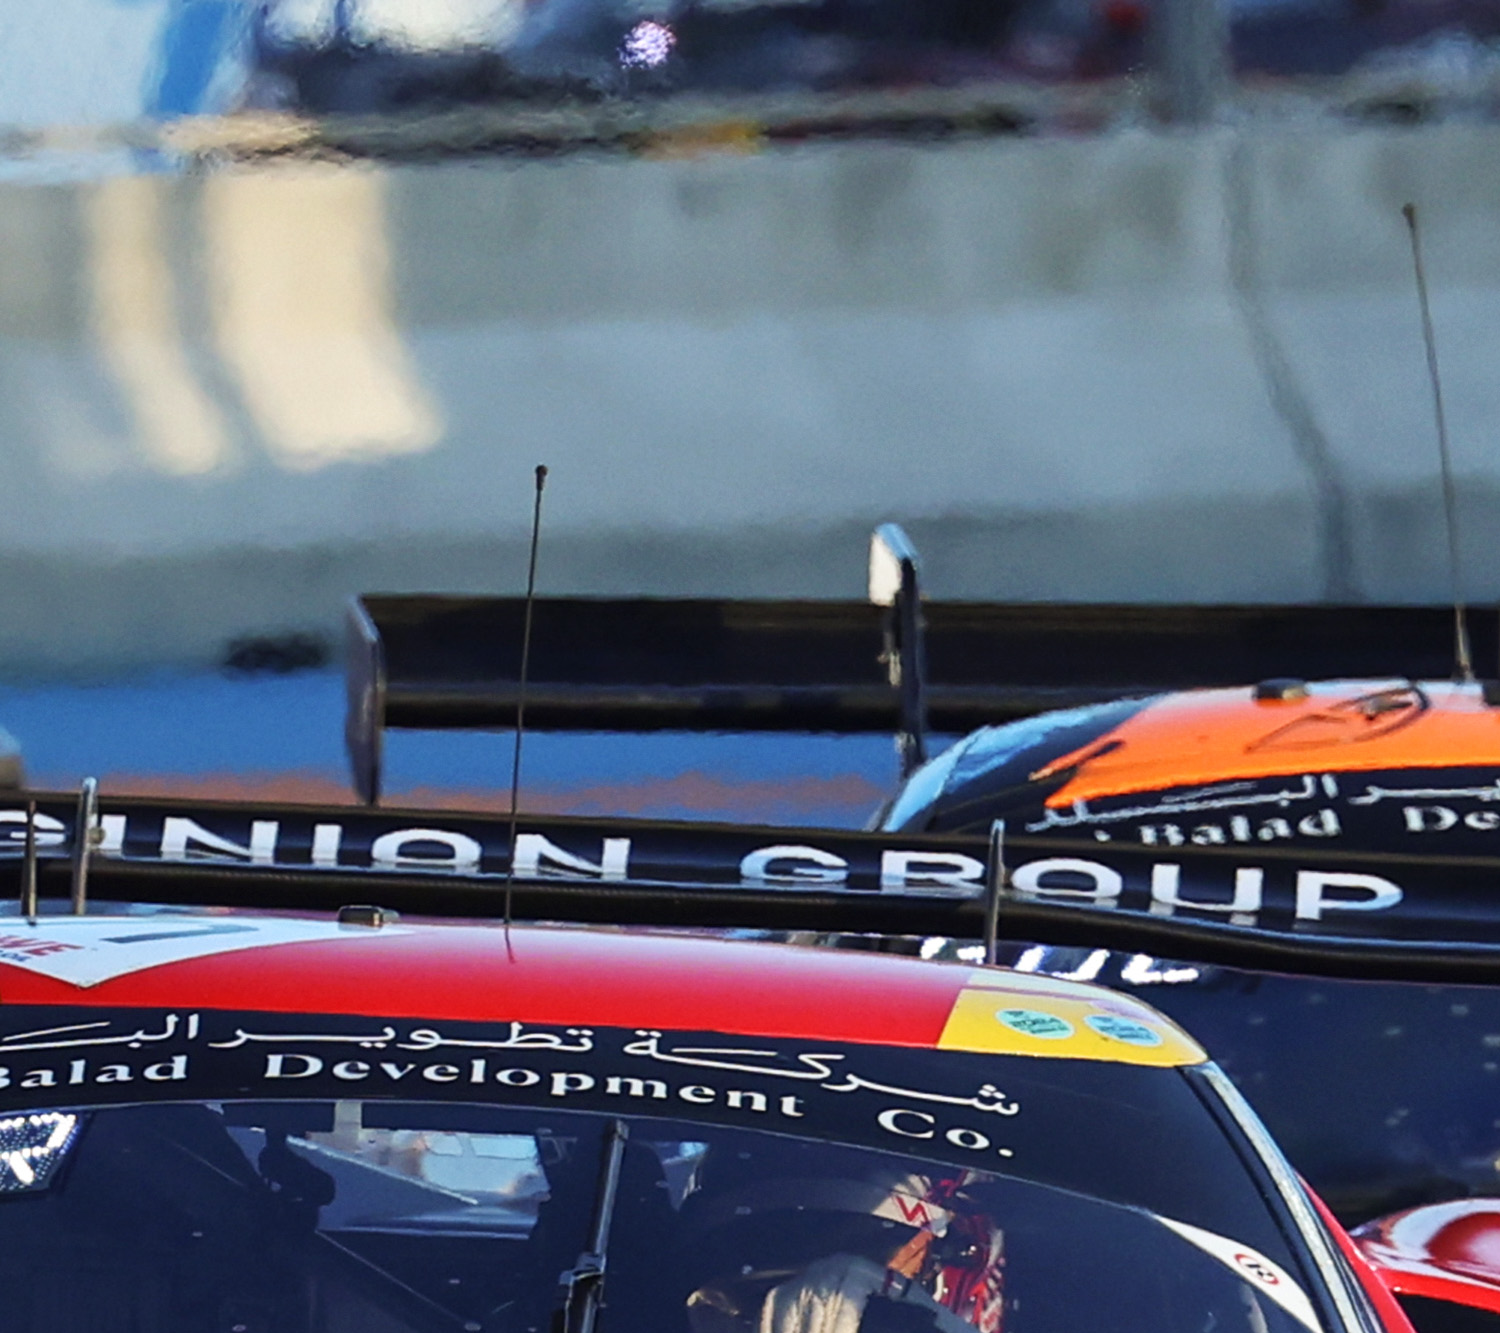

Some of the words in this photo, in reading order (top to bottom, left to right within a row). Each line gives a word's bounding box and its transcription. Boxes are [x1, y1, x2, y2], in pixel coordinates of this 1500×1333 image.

[739, 844, 1403, 920] GROUP
[207, 1022, 594, 1054] تطوير
[621, 1029, 1020, 1117] شركة
[264, 1055, 804, 1117] Development
[876, 1108, 1013, 1157] Co.
